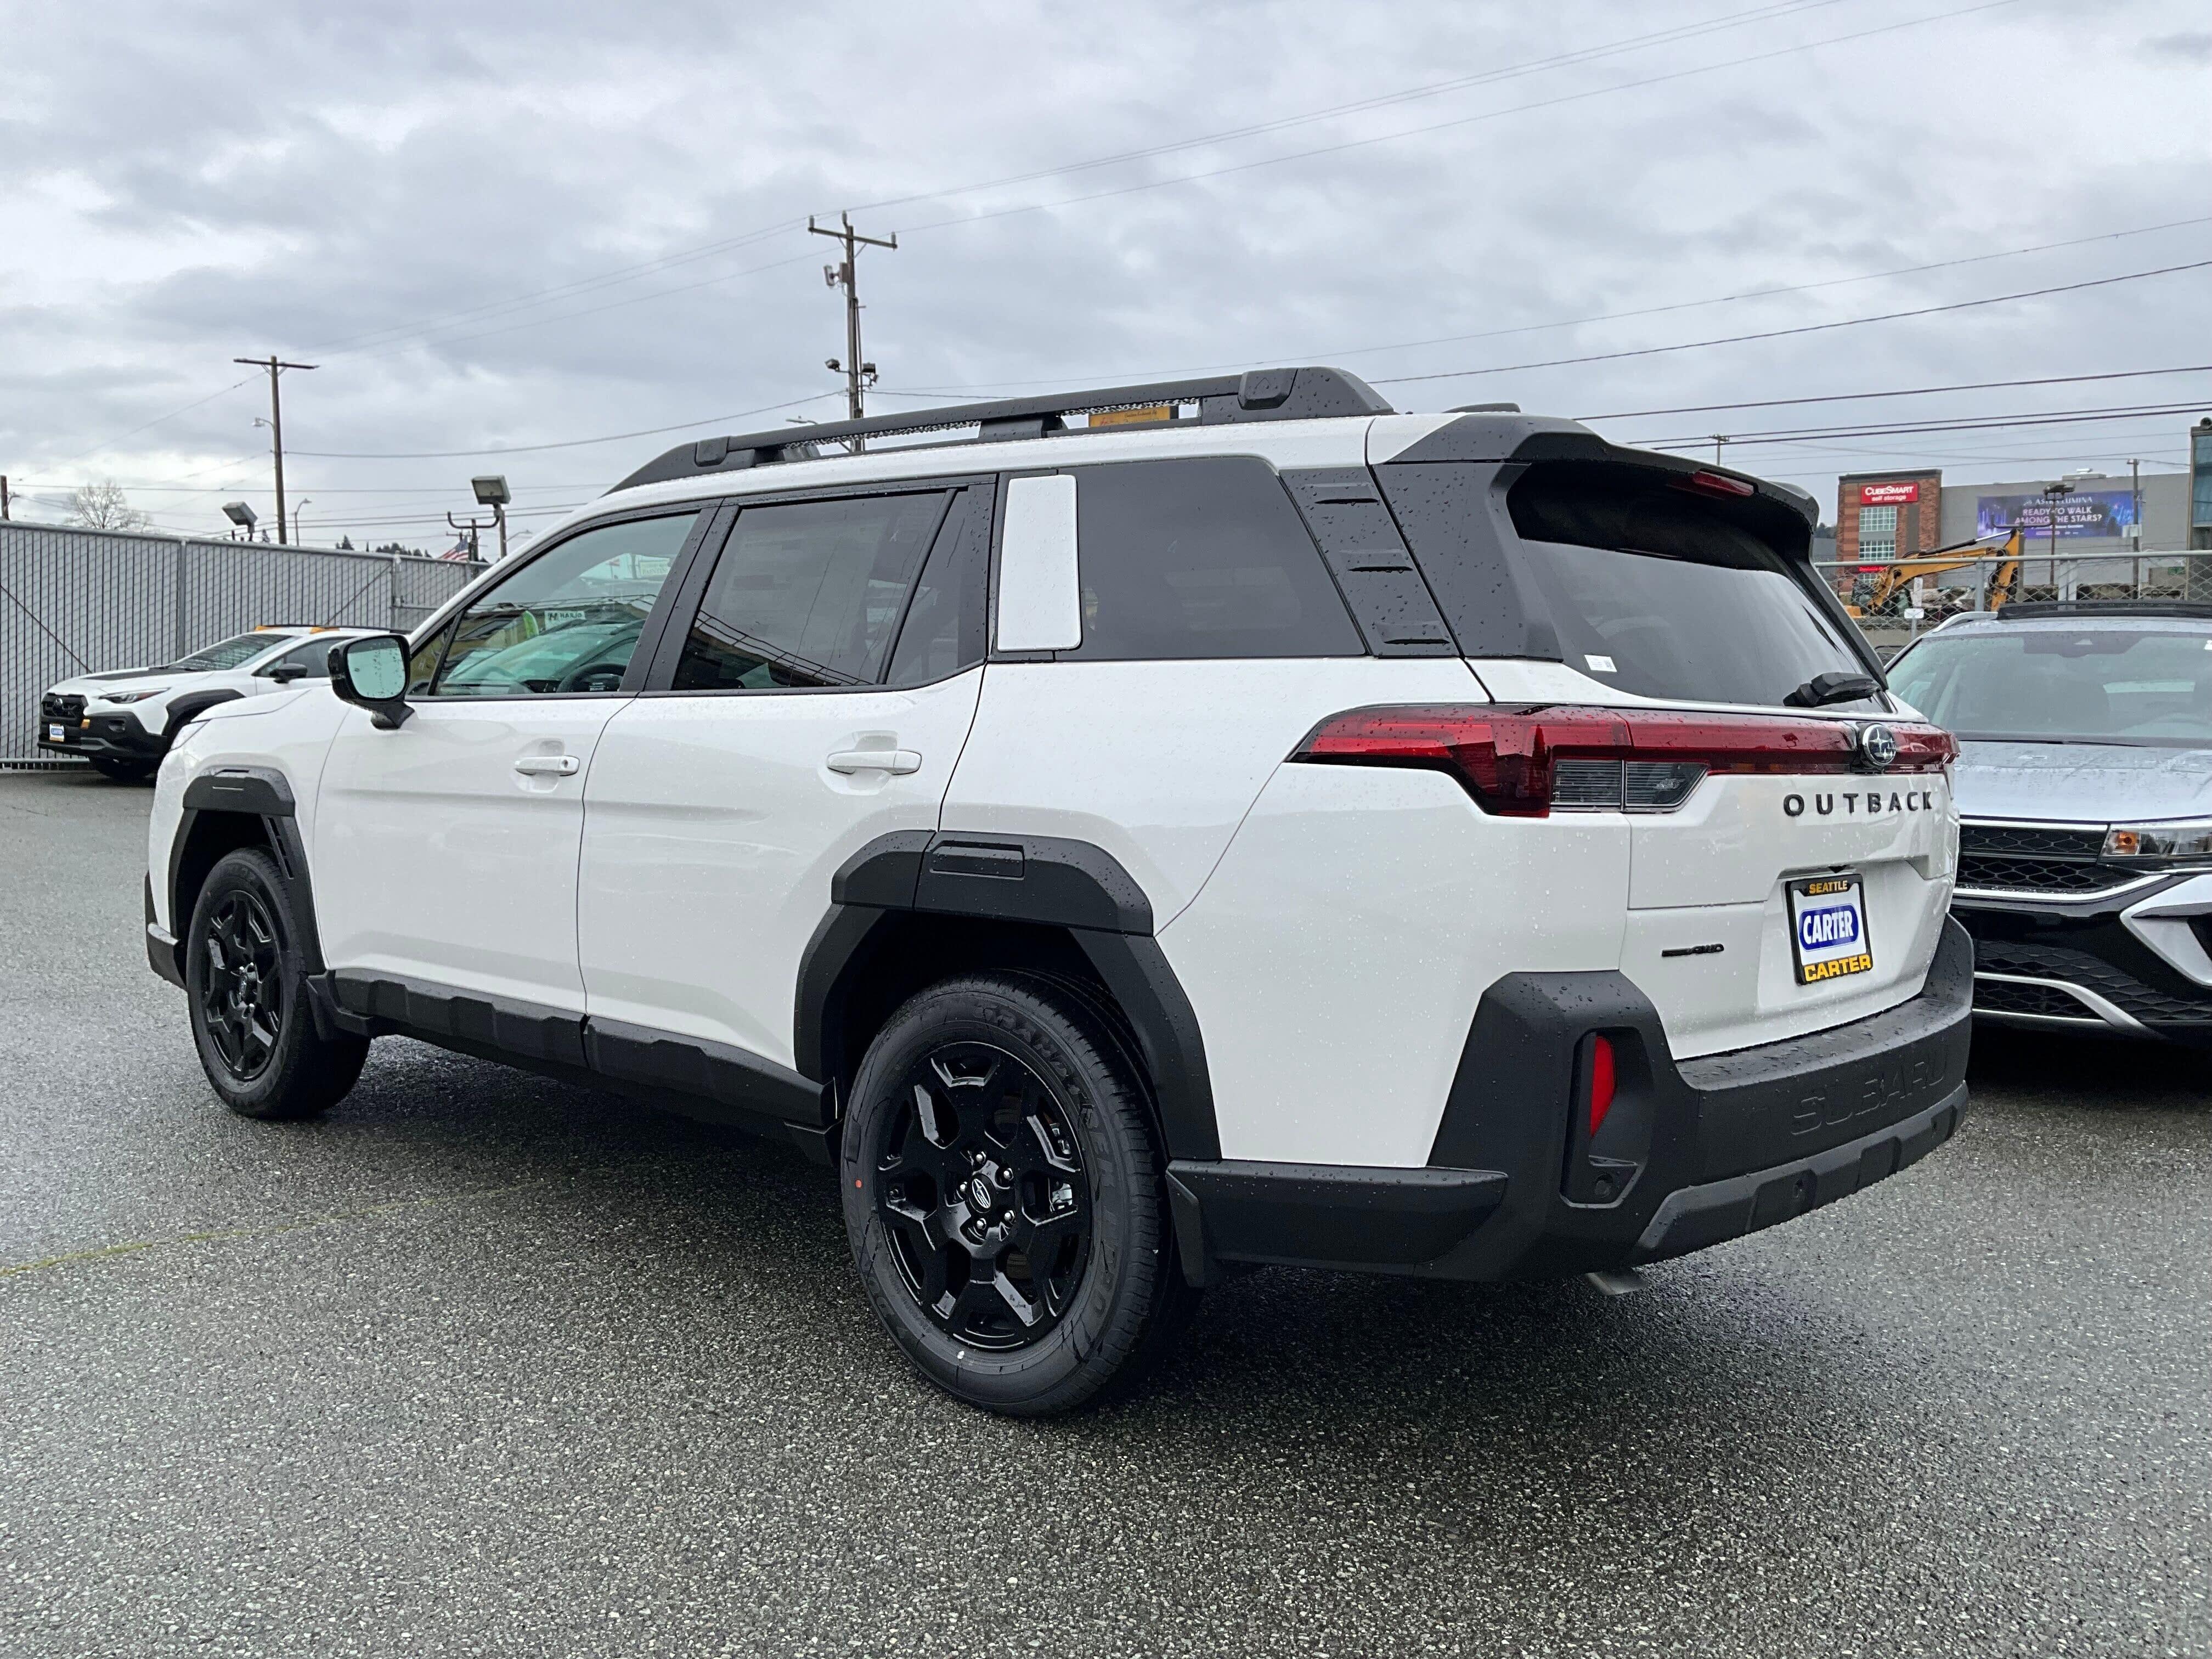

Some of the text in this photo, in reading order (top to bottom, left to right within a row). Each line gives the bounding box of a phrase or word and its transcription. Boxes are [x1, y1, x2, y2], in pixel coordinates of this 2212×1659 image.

[2015, 516, 2050, 524] AMONG
[2070, 514, 2102, 522] STARS?
[2067, 506, 2092, 515] WALK
[1782, 792, 1933, 817] OUTBACK
[1809, 880, 1848, 894] SEATTLE
[1802, 910, 1855, 945] CARTER
[1803, 954, 1872, 981] CARTER
[1791, 1049, 1948, 1135] SUBARU
